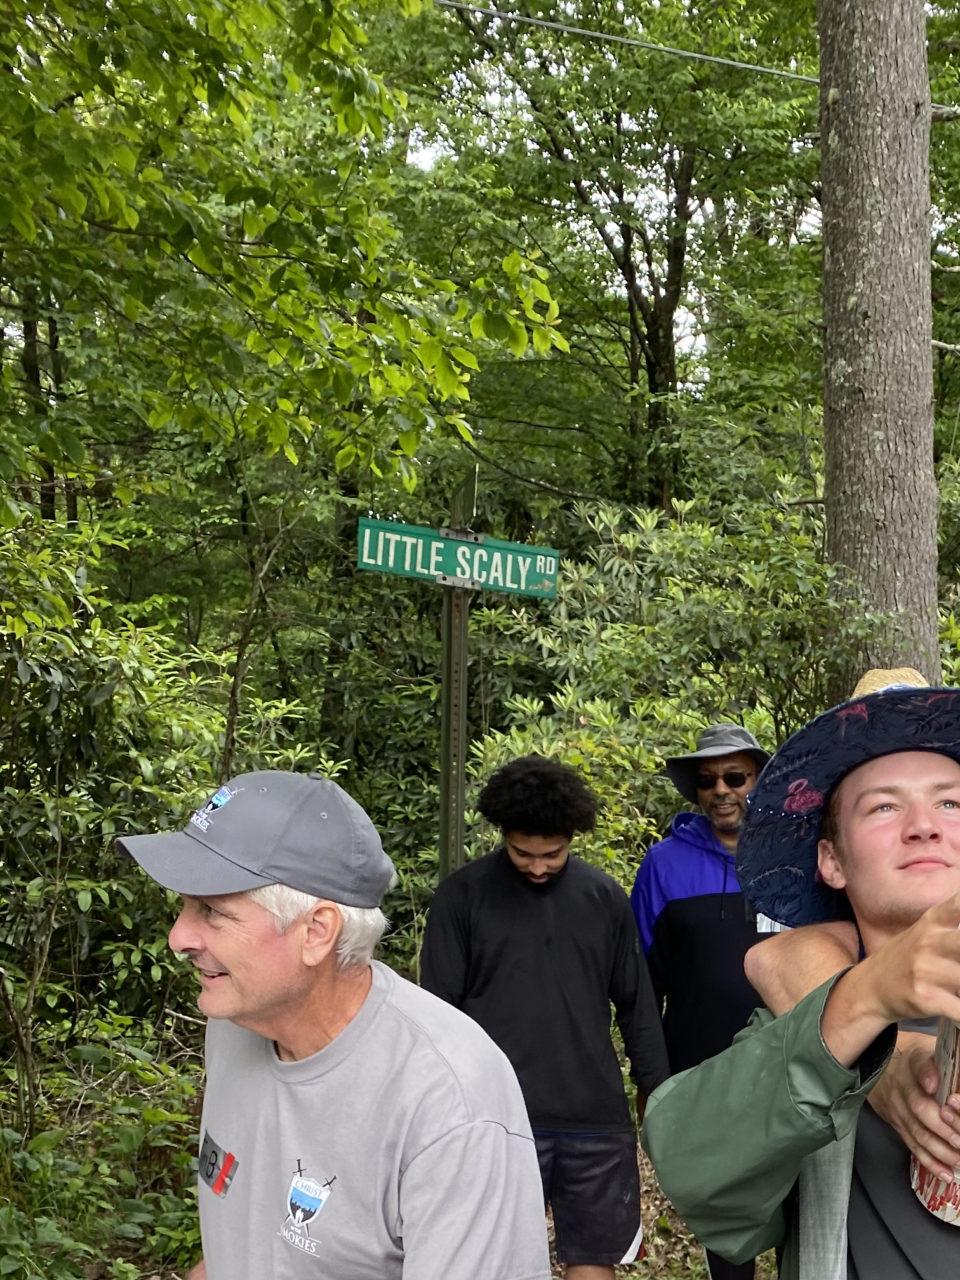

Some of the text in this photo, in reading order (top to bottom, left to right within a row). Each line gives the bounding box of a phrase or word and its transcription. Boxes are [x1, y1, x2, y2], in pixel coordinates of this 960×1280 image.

[362, 528, 556, 590] LITTLE SCALY RD
[295, 1180, 324, 1197] CHRIST
